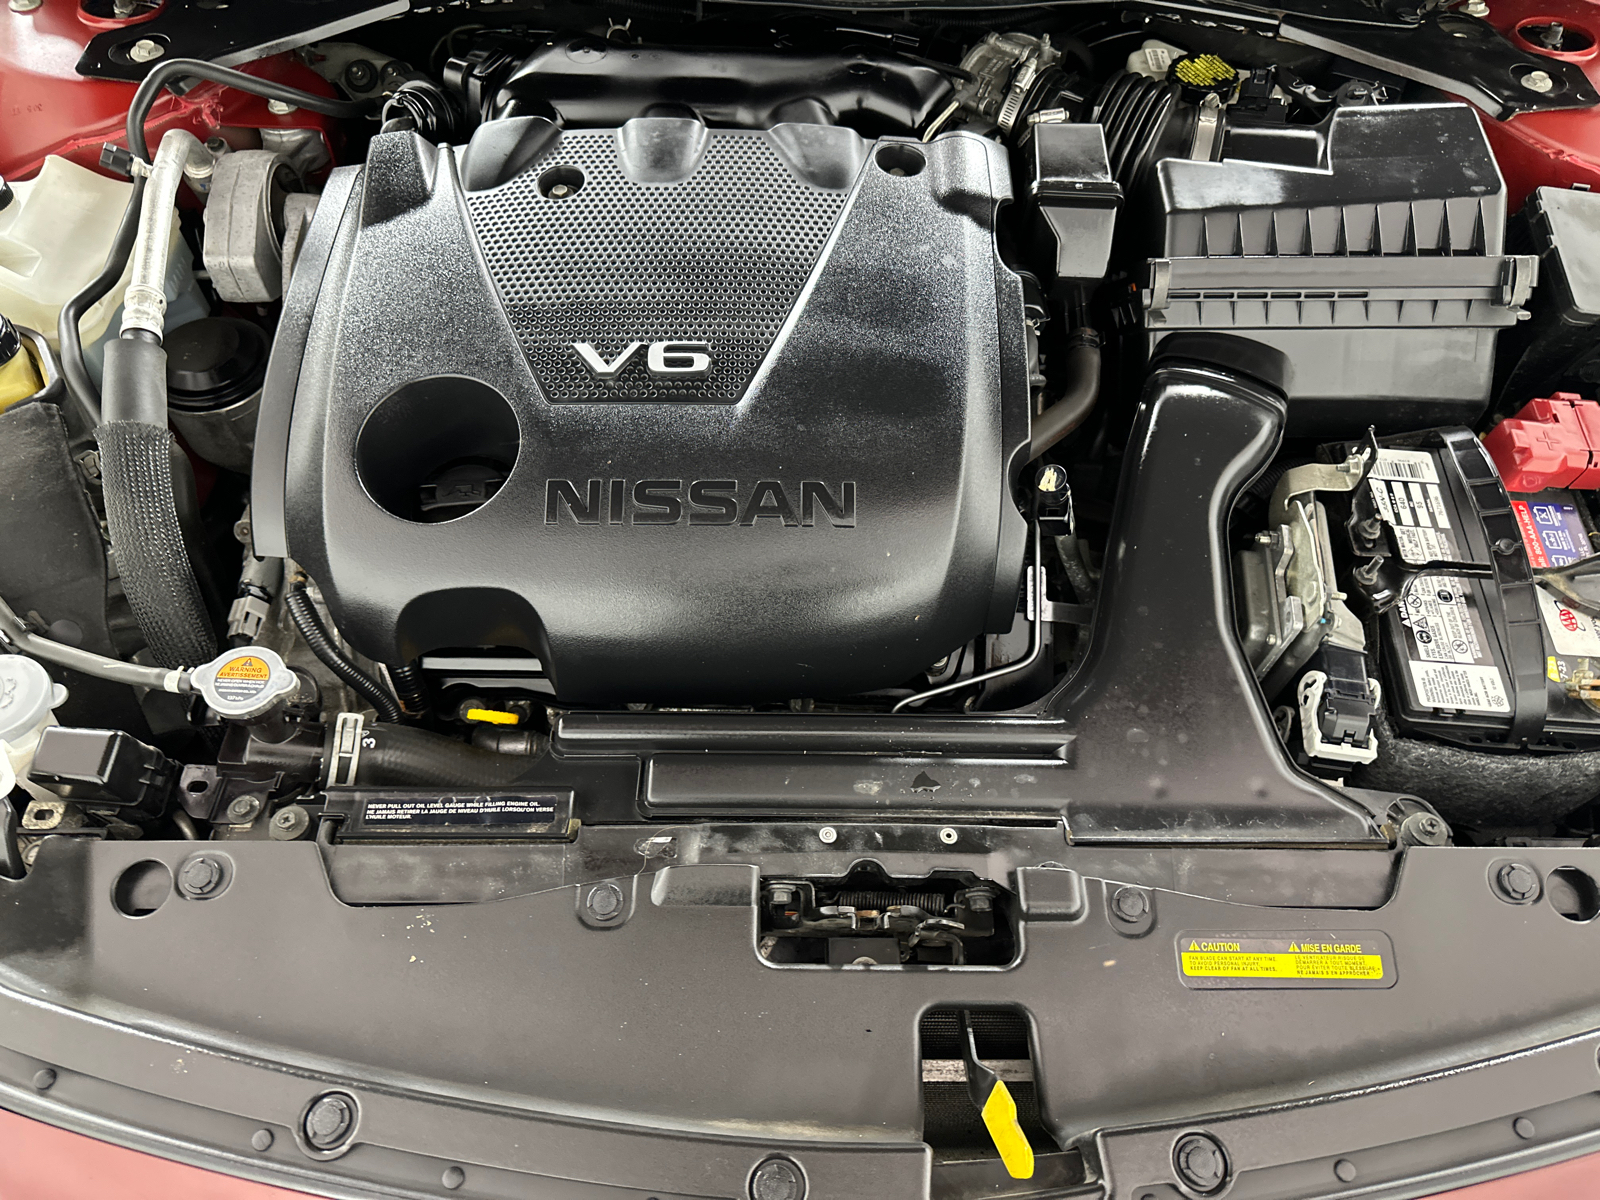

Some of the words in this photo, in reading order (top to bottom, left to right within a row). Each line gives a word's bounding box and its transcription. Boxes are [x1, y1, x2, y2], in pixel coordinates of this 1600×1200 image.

[570, 340, 711, 377] V6
[544, 479, 857, 528] NISSAN
[1398, 498, 1406, 509] 640
[1201, 942, 1240, 952] CAUTION
[1301, 944, 1320, 952] MISE
[1321, 944, 1332, 952] EN
[1334, 944, 1362, 953] GARDE
